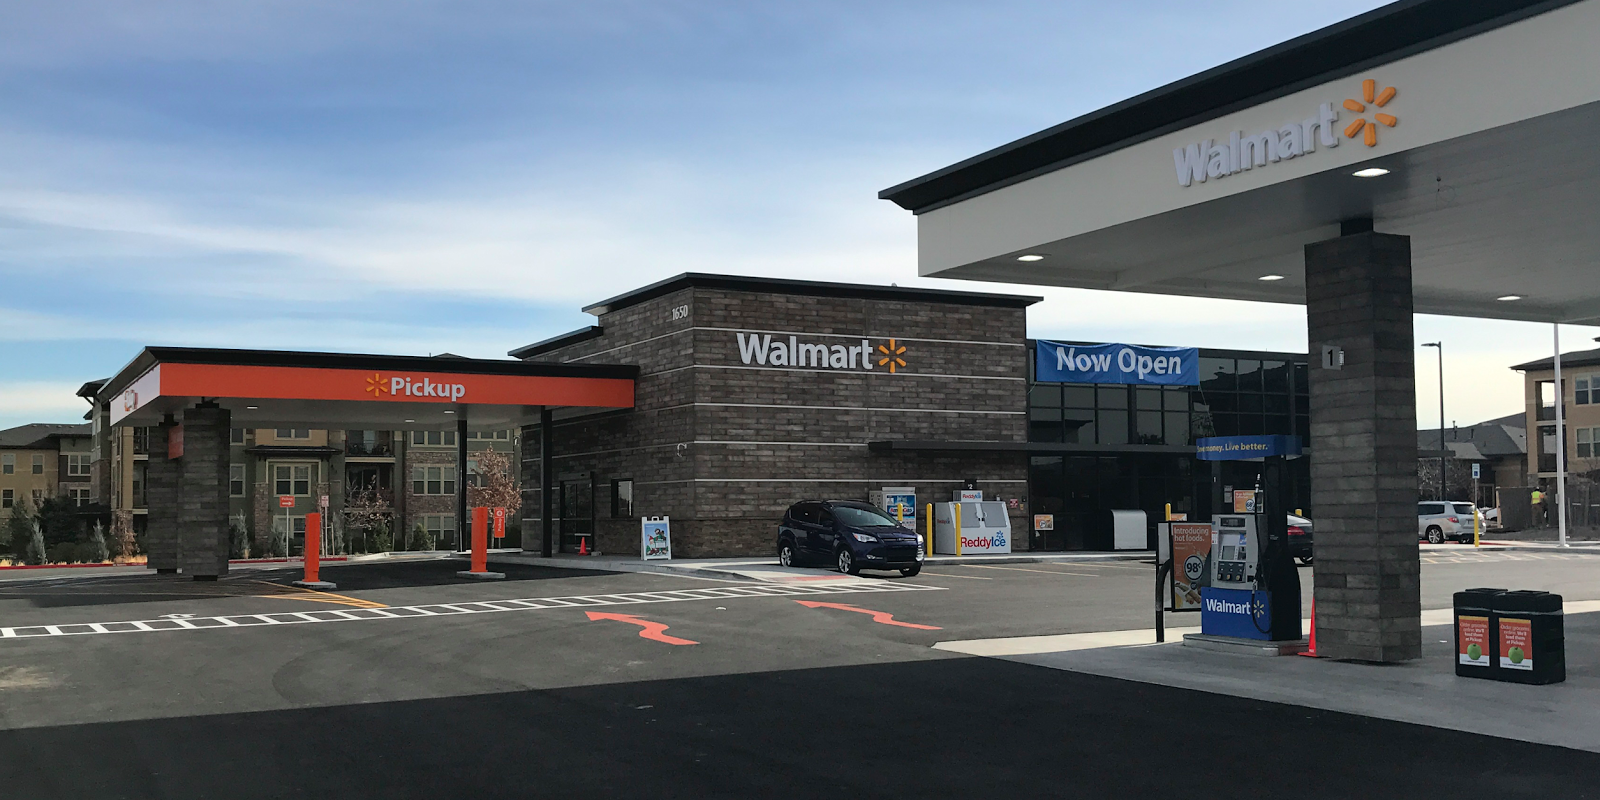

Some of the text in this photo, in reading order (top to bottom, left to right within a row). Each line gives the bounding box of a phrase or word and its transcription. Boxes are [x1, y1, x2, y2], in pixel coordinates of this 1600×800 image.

[1173, 102, 1338, 187] Walmart
[672, 305, 688, 320] 1650
[736, 333, 873, 370] Walmart
[1328, 350, 1333, 366] 1
[1056, 347, 1181, 379] Now Open
[391, 377, 465, 402] Pickup
[1225, 443, 1240, 451] Live
[1174, 527, 1209, 536] Introducing
[1206, 598, 1251, 615] Walmart
